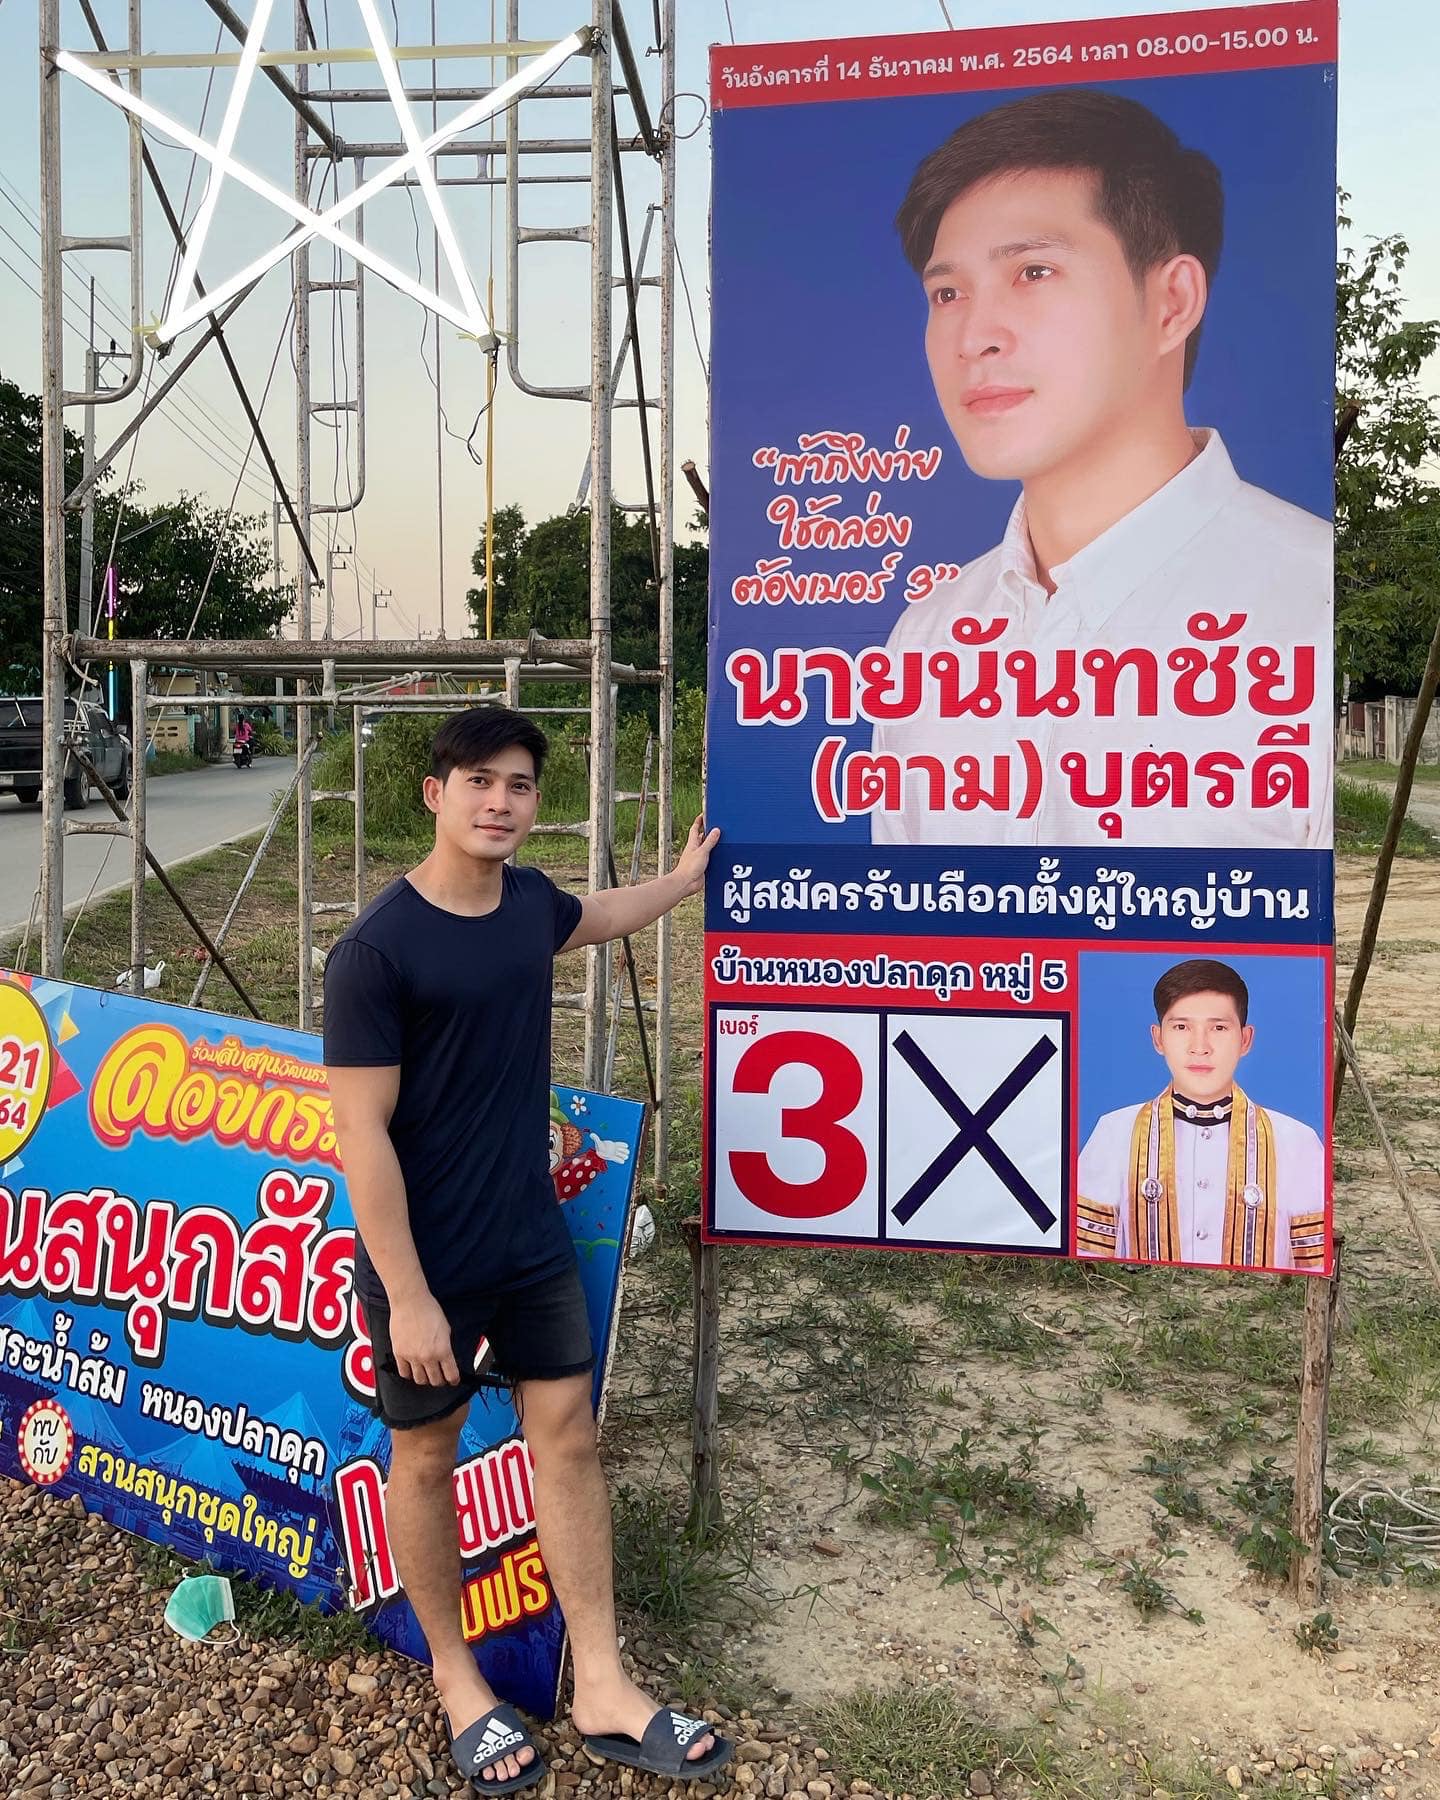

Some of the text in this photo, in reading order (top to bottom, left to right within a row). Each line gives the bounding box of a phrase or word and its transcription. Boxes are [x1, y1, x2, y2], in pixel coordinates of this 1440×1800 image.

[721, 25, 1319, 89] วันอังคารที่ 14 ธันวาคม พ.ศ. 2564 เวลา 08.00-15.00 น.
[767, 491, 912, 549] ใช้คล่อง
[727, 613, 1319, 725] นายนันทชัย
[812, 722, 1313, 840] (ตาม) บุตรดี
[722, 857, 1309, 929] ผู้สมัครรับเลือกตั้งผู้ใหญ่บ้าน
[712, 944, 1068, 1001] บ้านหนองปลาดุก หมู่ 5
[720, 1015, 759, 1035] เบอร์
[0, 1041, 39, 1089] 21
[191, 1039, 329, 1083] ร่วมสืบสานวัฒนธร
[90, 1025, 343, 1162] ลอยกระ
[729, 1031, 867, 1219] 3
[32, 1418, 60, 1437] พบ
[32, 1439, 58, 1465] กับ
[141, 1383, 325, 1484] หนองปลาดุก
[78, 1445, 317, 1578] สวนสนุกชุดใหญ่
[473, 1731, 524, 1764] adidas
